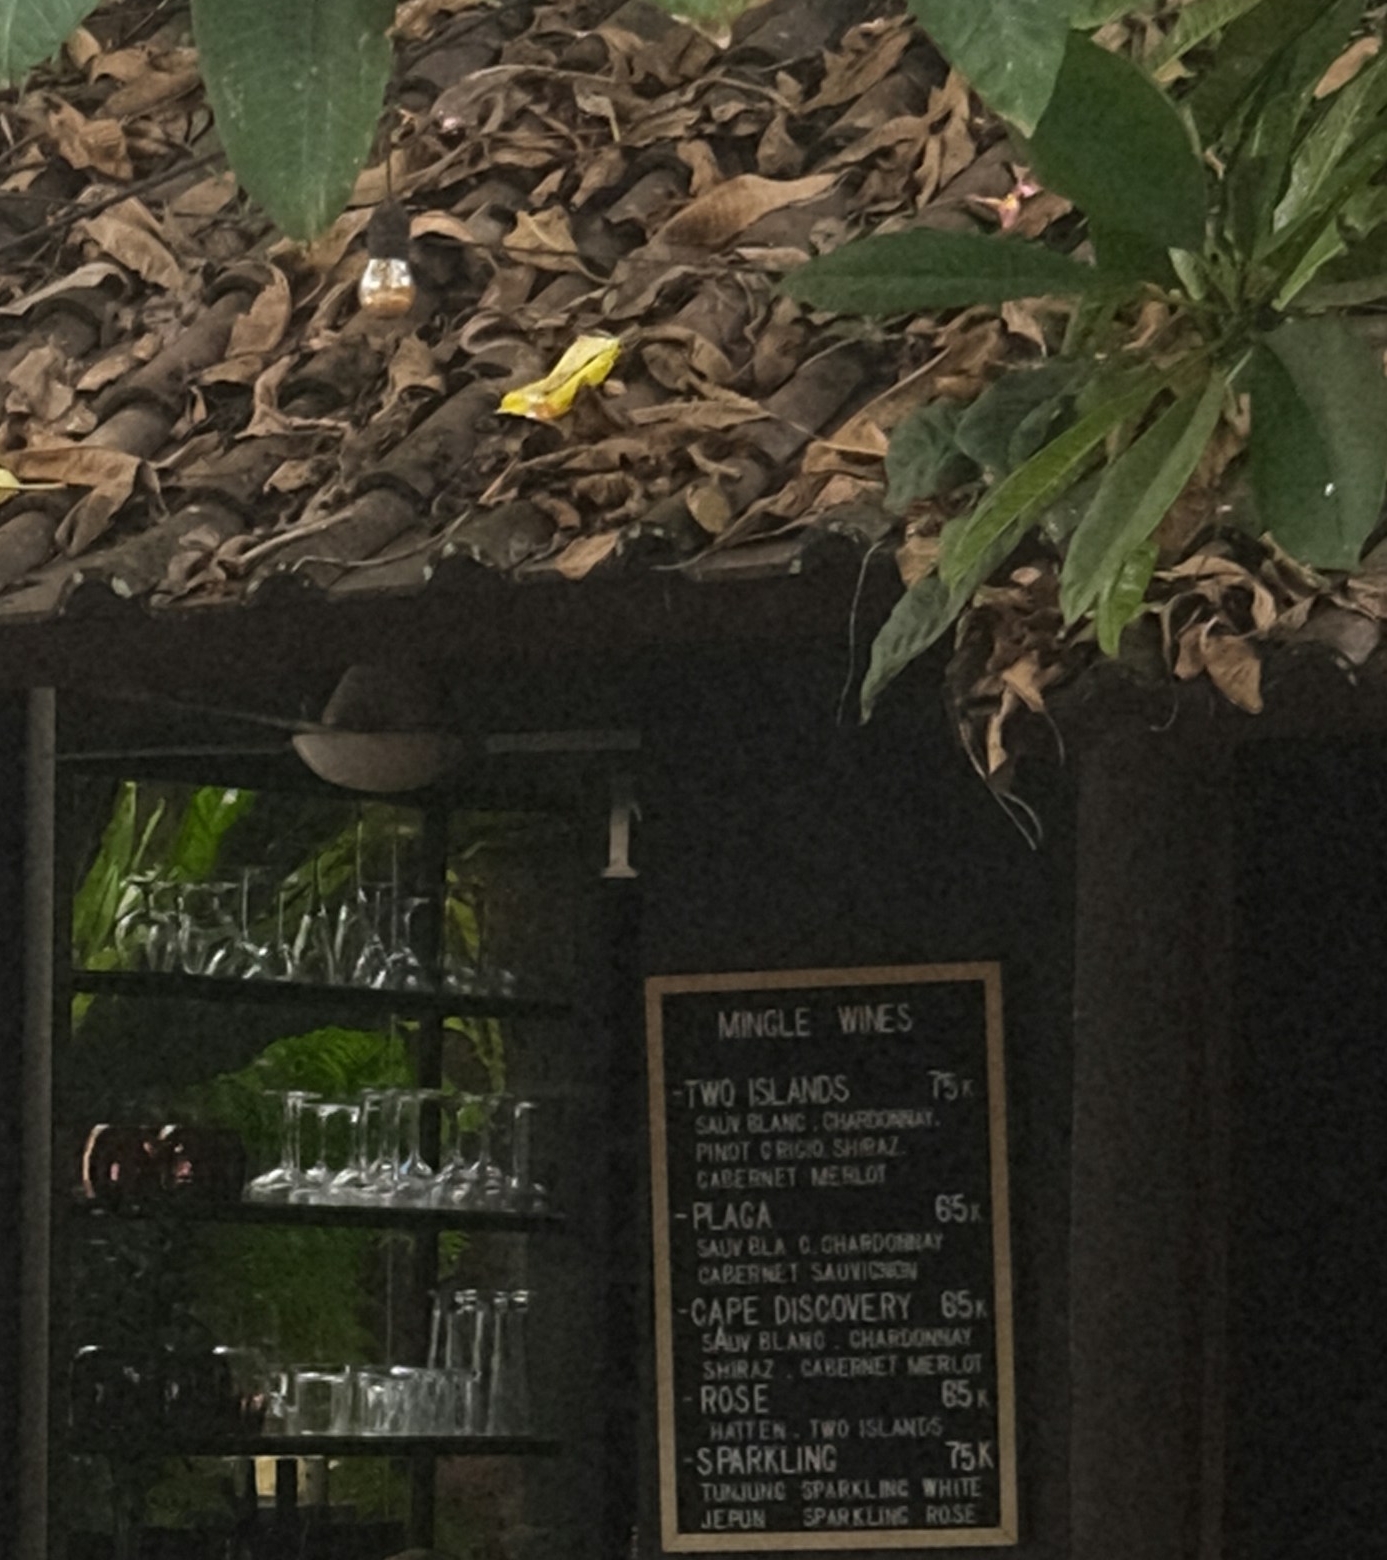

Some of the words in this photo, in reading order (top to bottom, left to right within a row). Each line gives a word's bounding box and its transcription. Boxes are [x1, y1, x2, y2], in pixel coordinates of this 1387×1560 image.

[718, 1008, 811, 1039] MINGLE
[839, 1004, 913, 1034] WINES
[749, 1075, 850, 1106] ISLANDS
[696, 1142, 750, 1162] PINOT
[697, 1167, 797, 1189] CABERNET
[811, 1164, 886, 1187] MERLOT
[698, 1263, 797, 1284] CABERNET
[775, 1293, 912, 1324] DISCOVERY
[702, 1359, 774, 1380] SHIRAZ
[801, 1355, 897, 1377] CABERNET
[811, 1419, 848, 1438] TWO
[859, 1417, 943, 1436] ISLANDS
[922, 1477, 982, 1498] WHITE
[701, 1509, 766, 1529] JEPUN
[926, 1505, 976, 1524] ROSE
